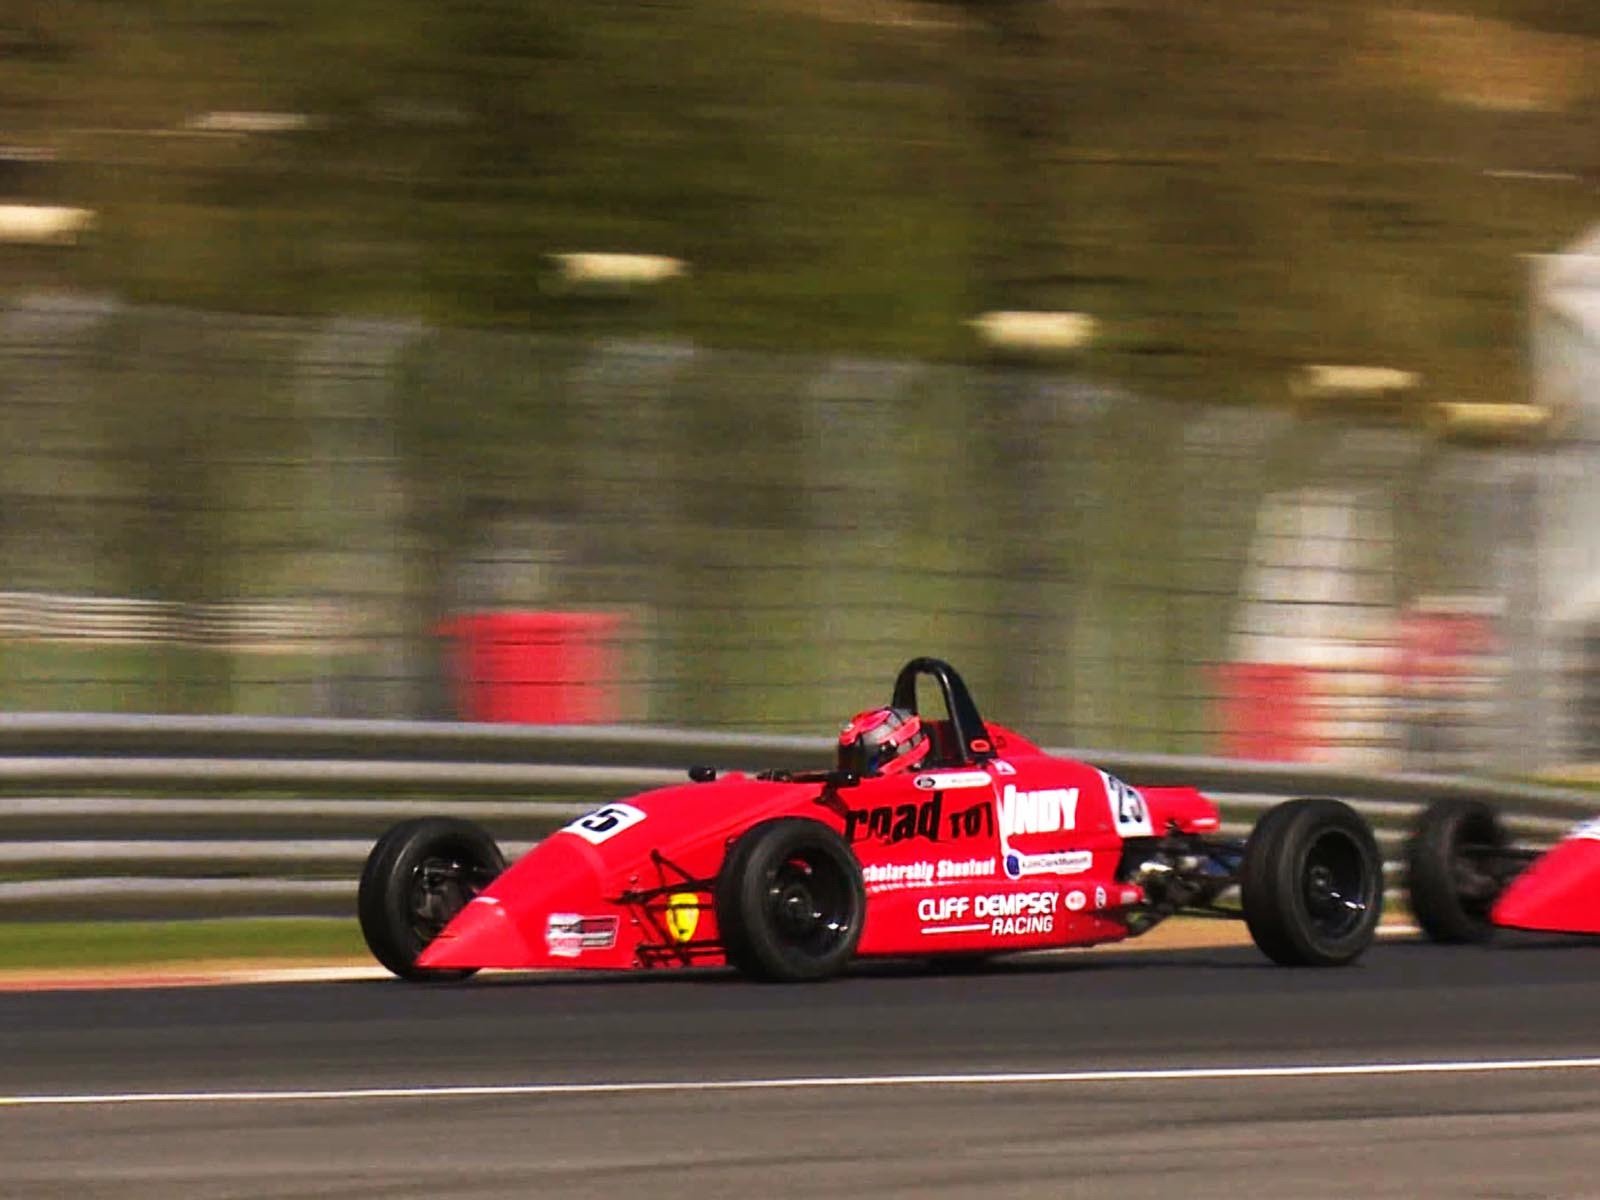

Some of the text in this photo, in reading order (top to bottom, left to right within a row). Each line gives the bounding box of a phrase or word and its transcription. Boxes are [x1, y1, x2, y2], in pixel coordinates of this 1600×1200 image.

[1002, 784, 1080, 836] INDY
[917, 896, 970, 921] CLIFF
[974, 892, 1060, 918] DEMPSEY
[991, 915, 1054, 936] RACING
